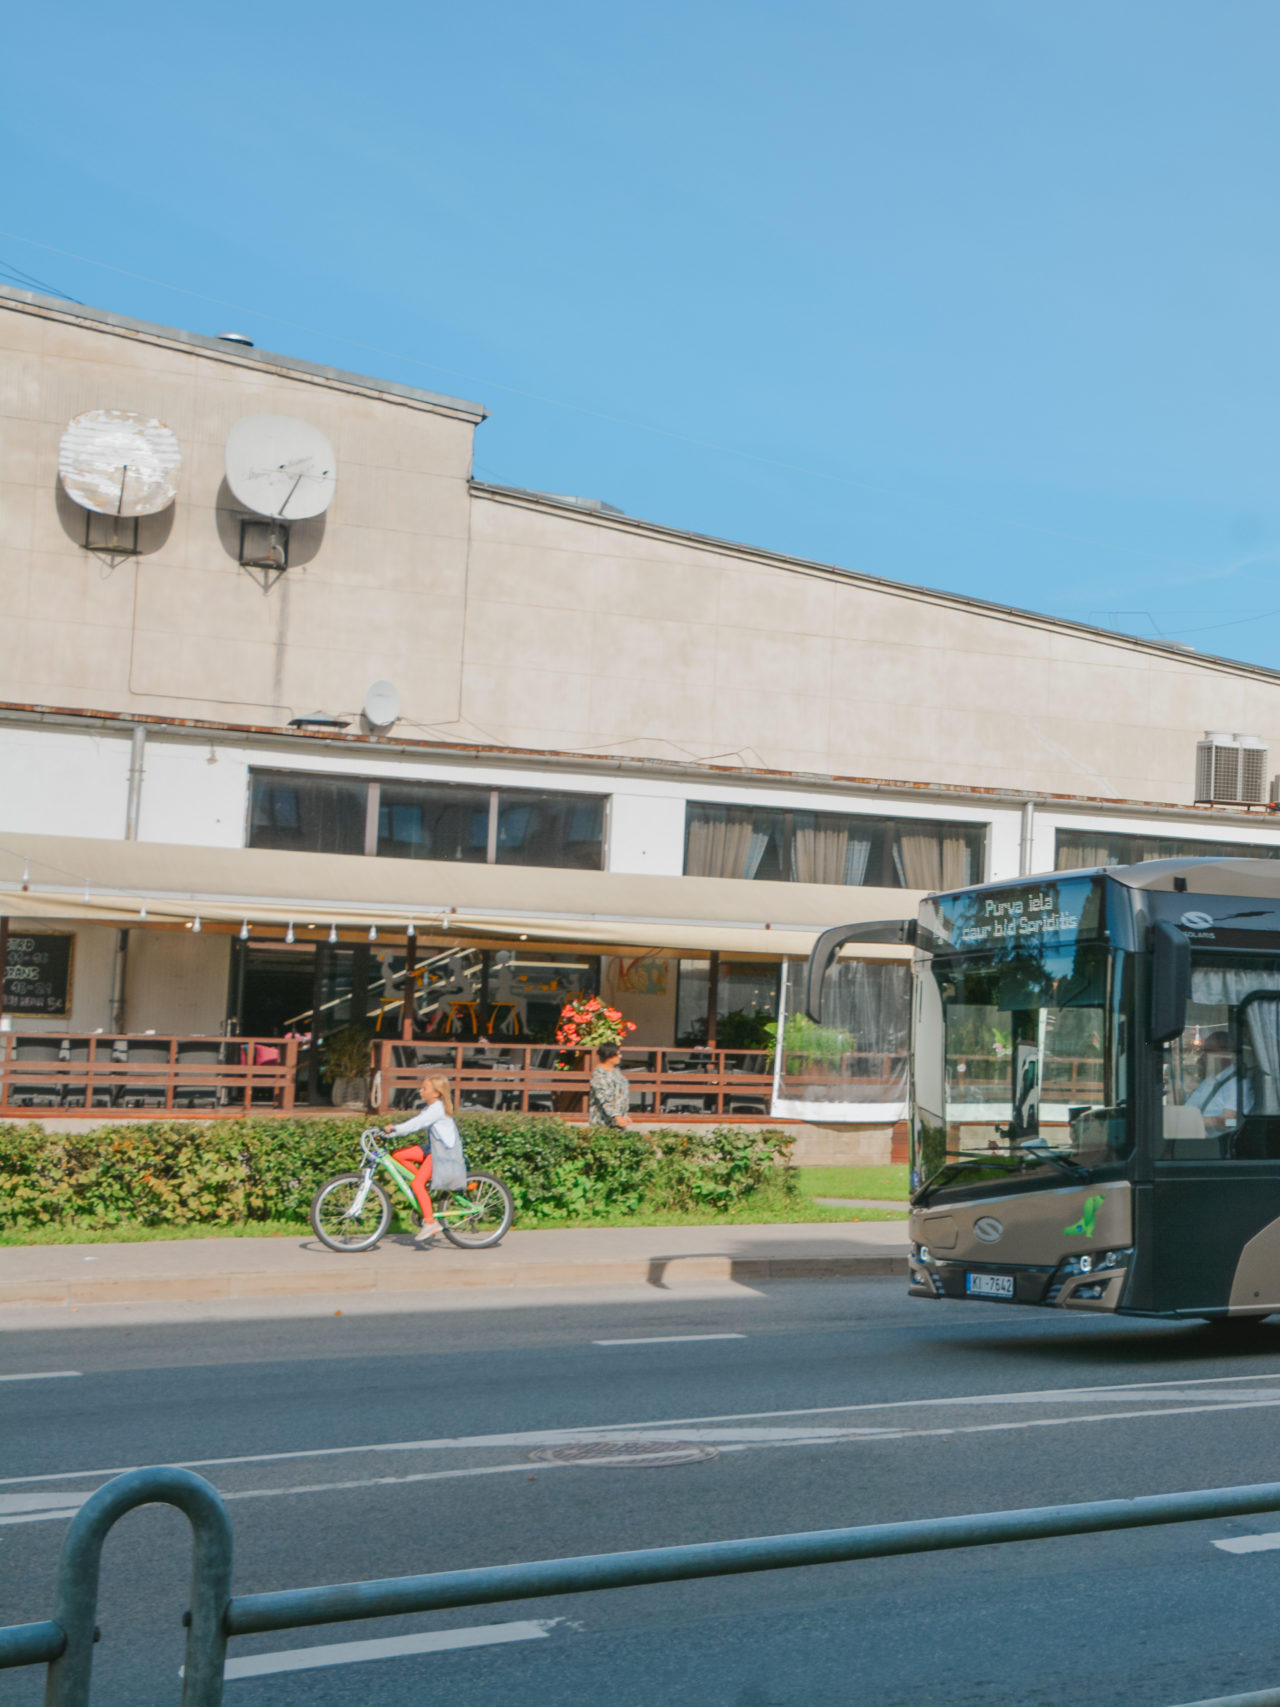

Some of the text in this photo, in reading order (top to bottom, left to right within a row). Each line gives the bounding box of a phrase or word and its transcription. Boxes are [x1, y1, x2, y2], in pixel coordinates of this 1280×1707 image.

[984, 892, 1053, 918] Purva iela
[961, 924, 992, 940] caur
